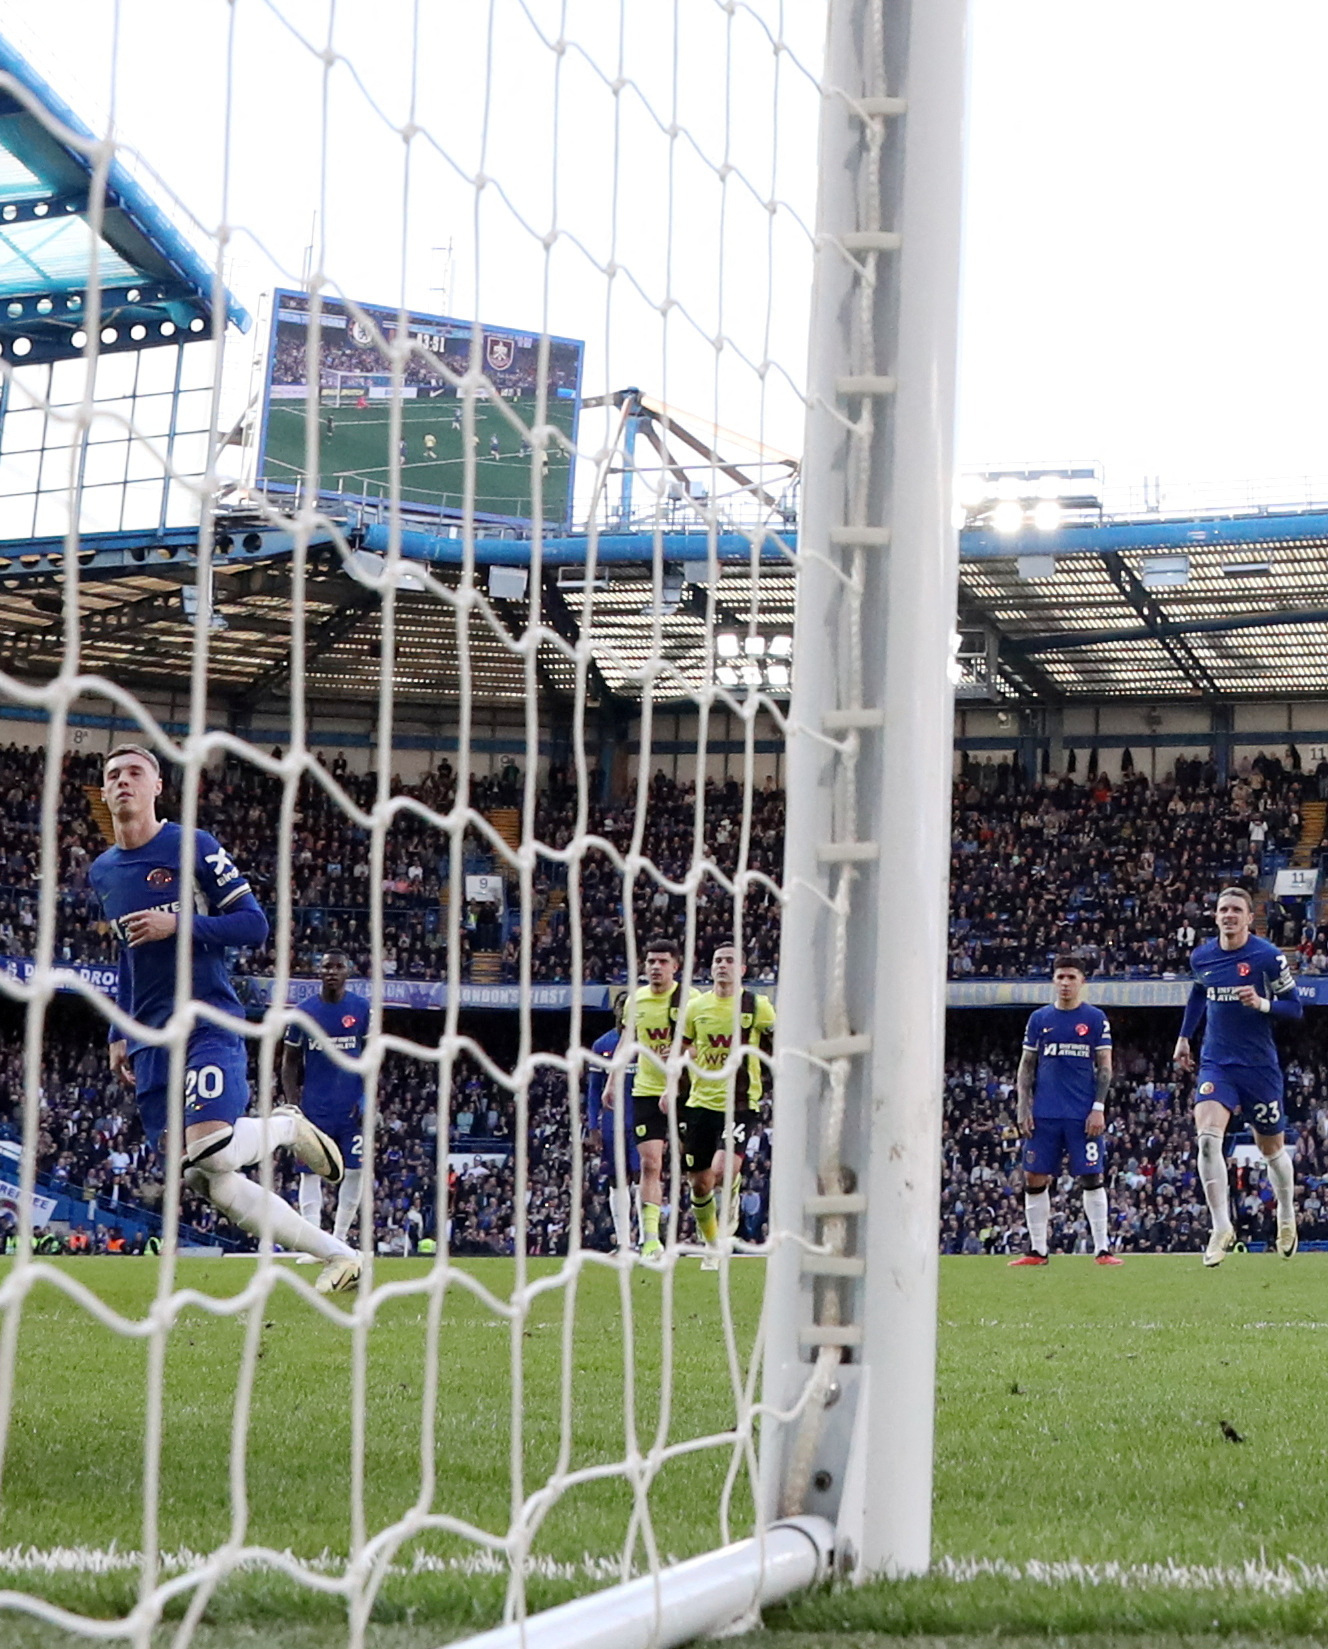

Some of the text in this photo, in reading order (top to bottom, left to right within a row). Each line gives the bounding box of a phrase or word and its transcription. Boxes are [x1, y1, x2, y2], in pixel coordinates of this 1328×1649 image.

[479, 878, 488, 889] 9
[1291, 872, 1305, 884] 11
[80, 968, 119, 986] DRO
[459, 988, 519, 1003] ONDON'S
[1296, 986, 1316, 998] W6
[705, 1052, 728, 1066] W8
[185, 1065, 223, 1107] 20
[1253, 1100, 1281, 1124] 23
[1085, 1141, 1099, 1162] 8
